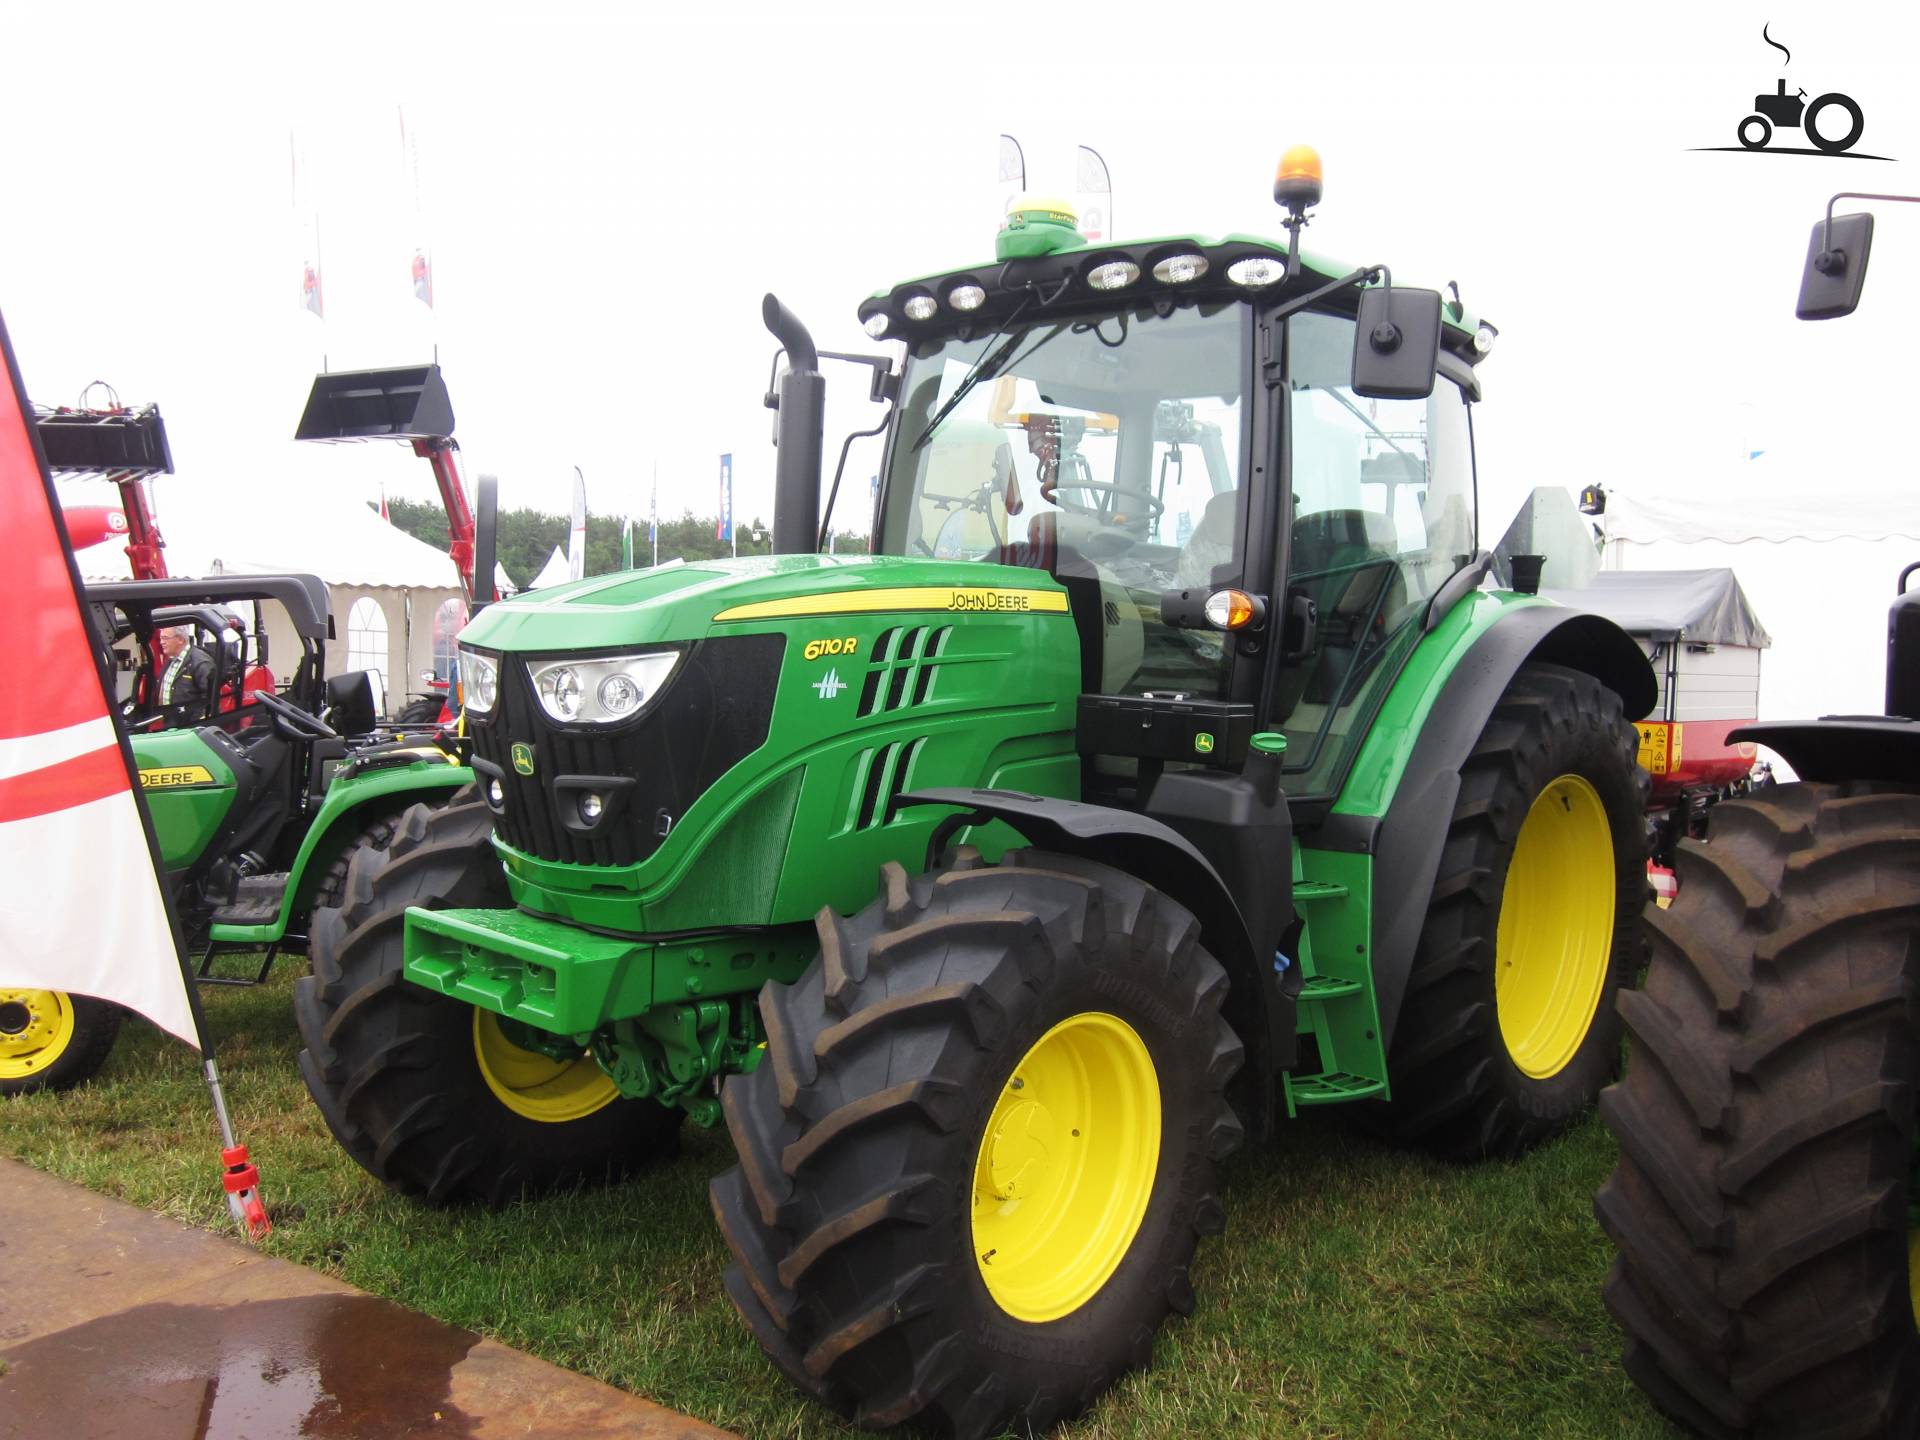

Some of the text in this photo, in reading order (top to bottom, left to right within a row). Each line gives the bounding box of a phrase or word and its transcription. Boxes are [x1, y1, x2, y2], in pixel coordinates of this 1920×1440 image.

[948, 591, 1029, 609] JOHN DEERE
[139, 772, 193, 786] DEERE
